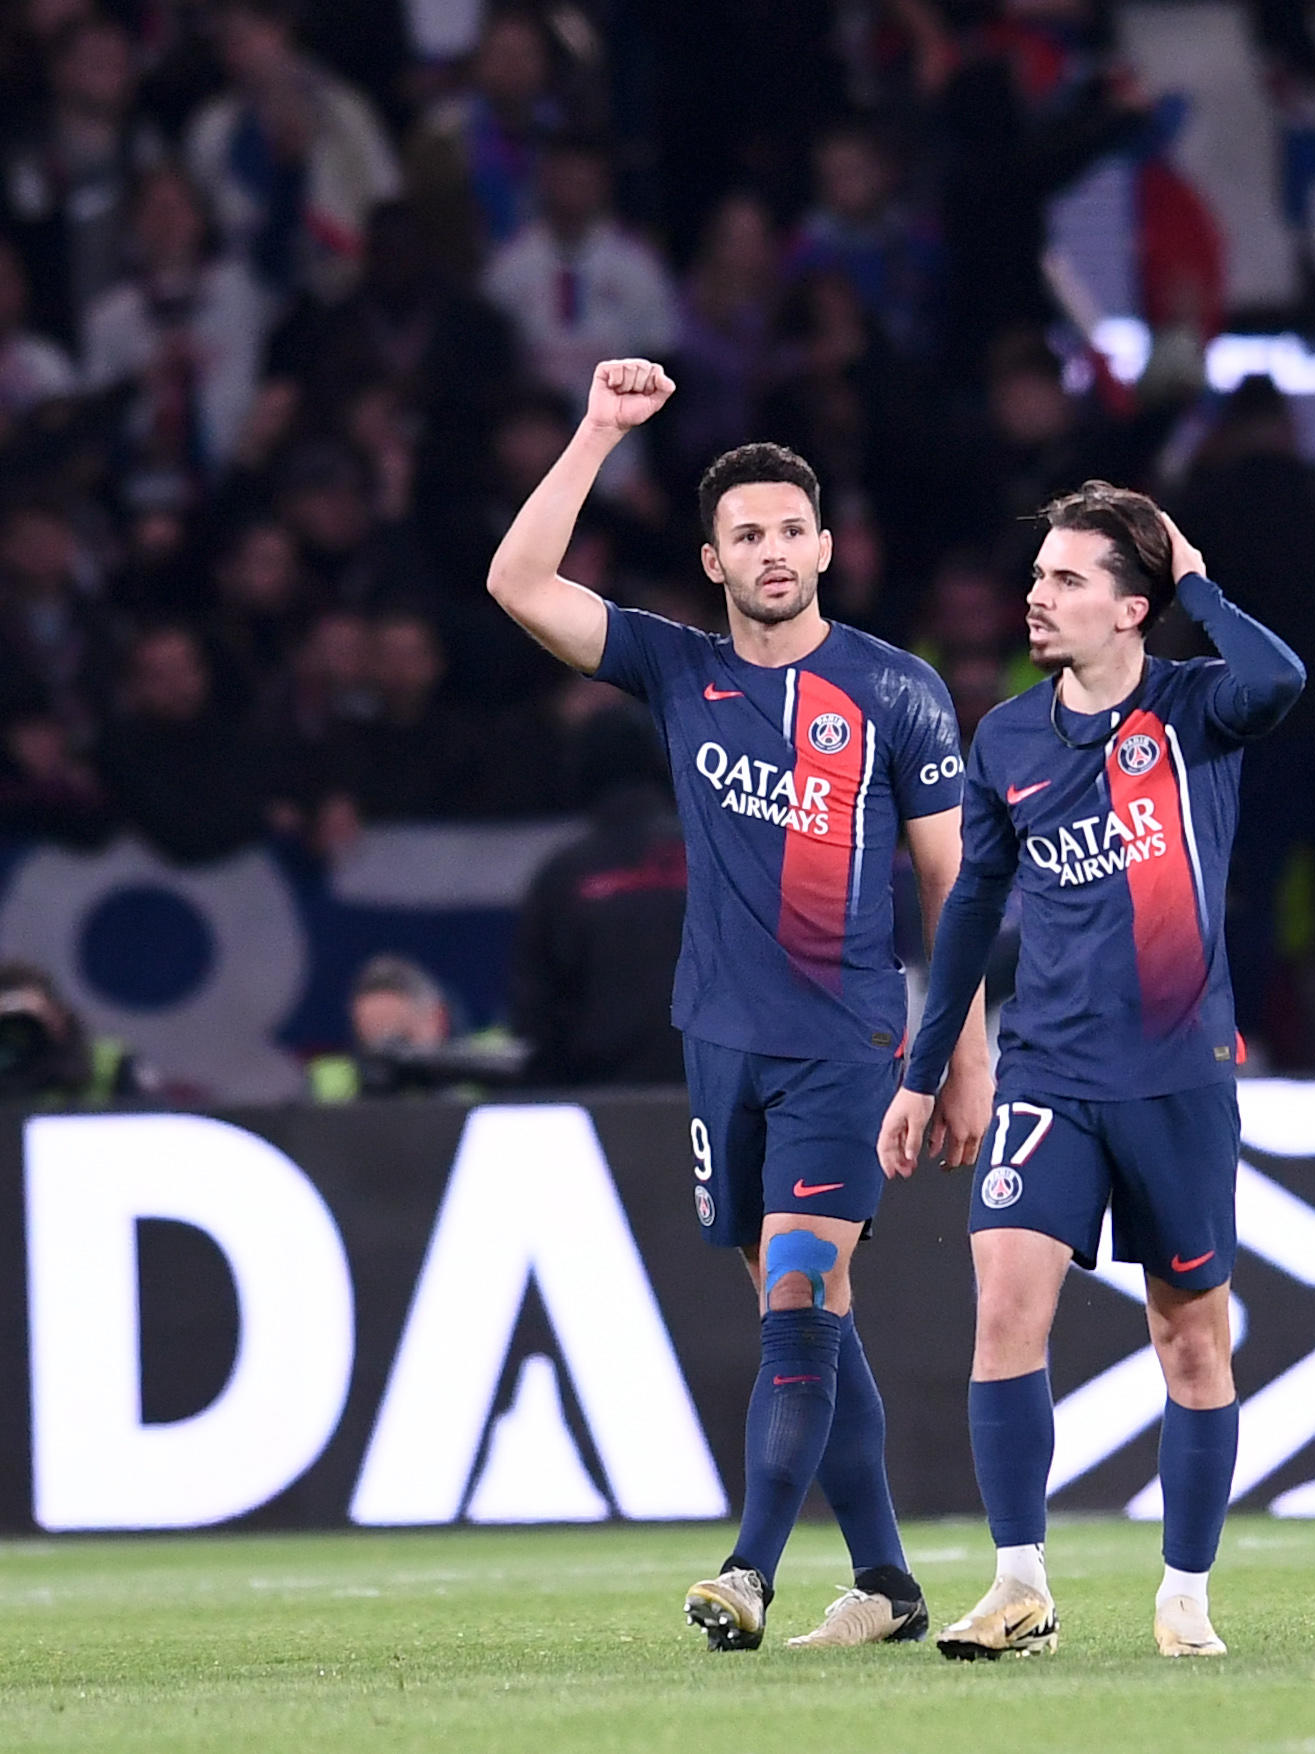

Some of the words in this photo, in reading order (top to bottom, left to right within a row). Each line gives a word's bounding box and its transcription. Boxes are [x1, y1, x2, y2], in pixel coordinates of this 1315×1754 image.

[696, 741, 831, 812] QATAR
[920, 755, 964, 785] GO
[721, 789, 829, 835] AIRWAYS
[1027, 798, 1163, 874] QATAR
[1060, 833, 1167, 887] AIRWAYS
[690, 1117, 712, 1181] 9
[991, 1101, 1054, 1166] 17
[24, 1104, 729, 1531] DA
